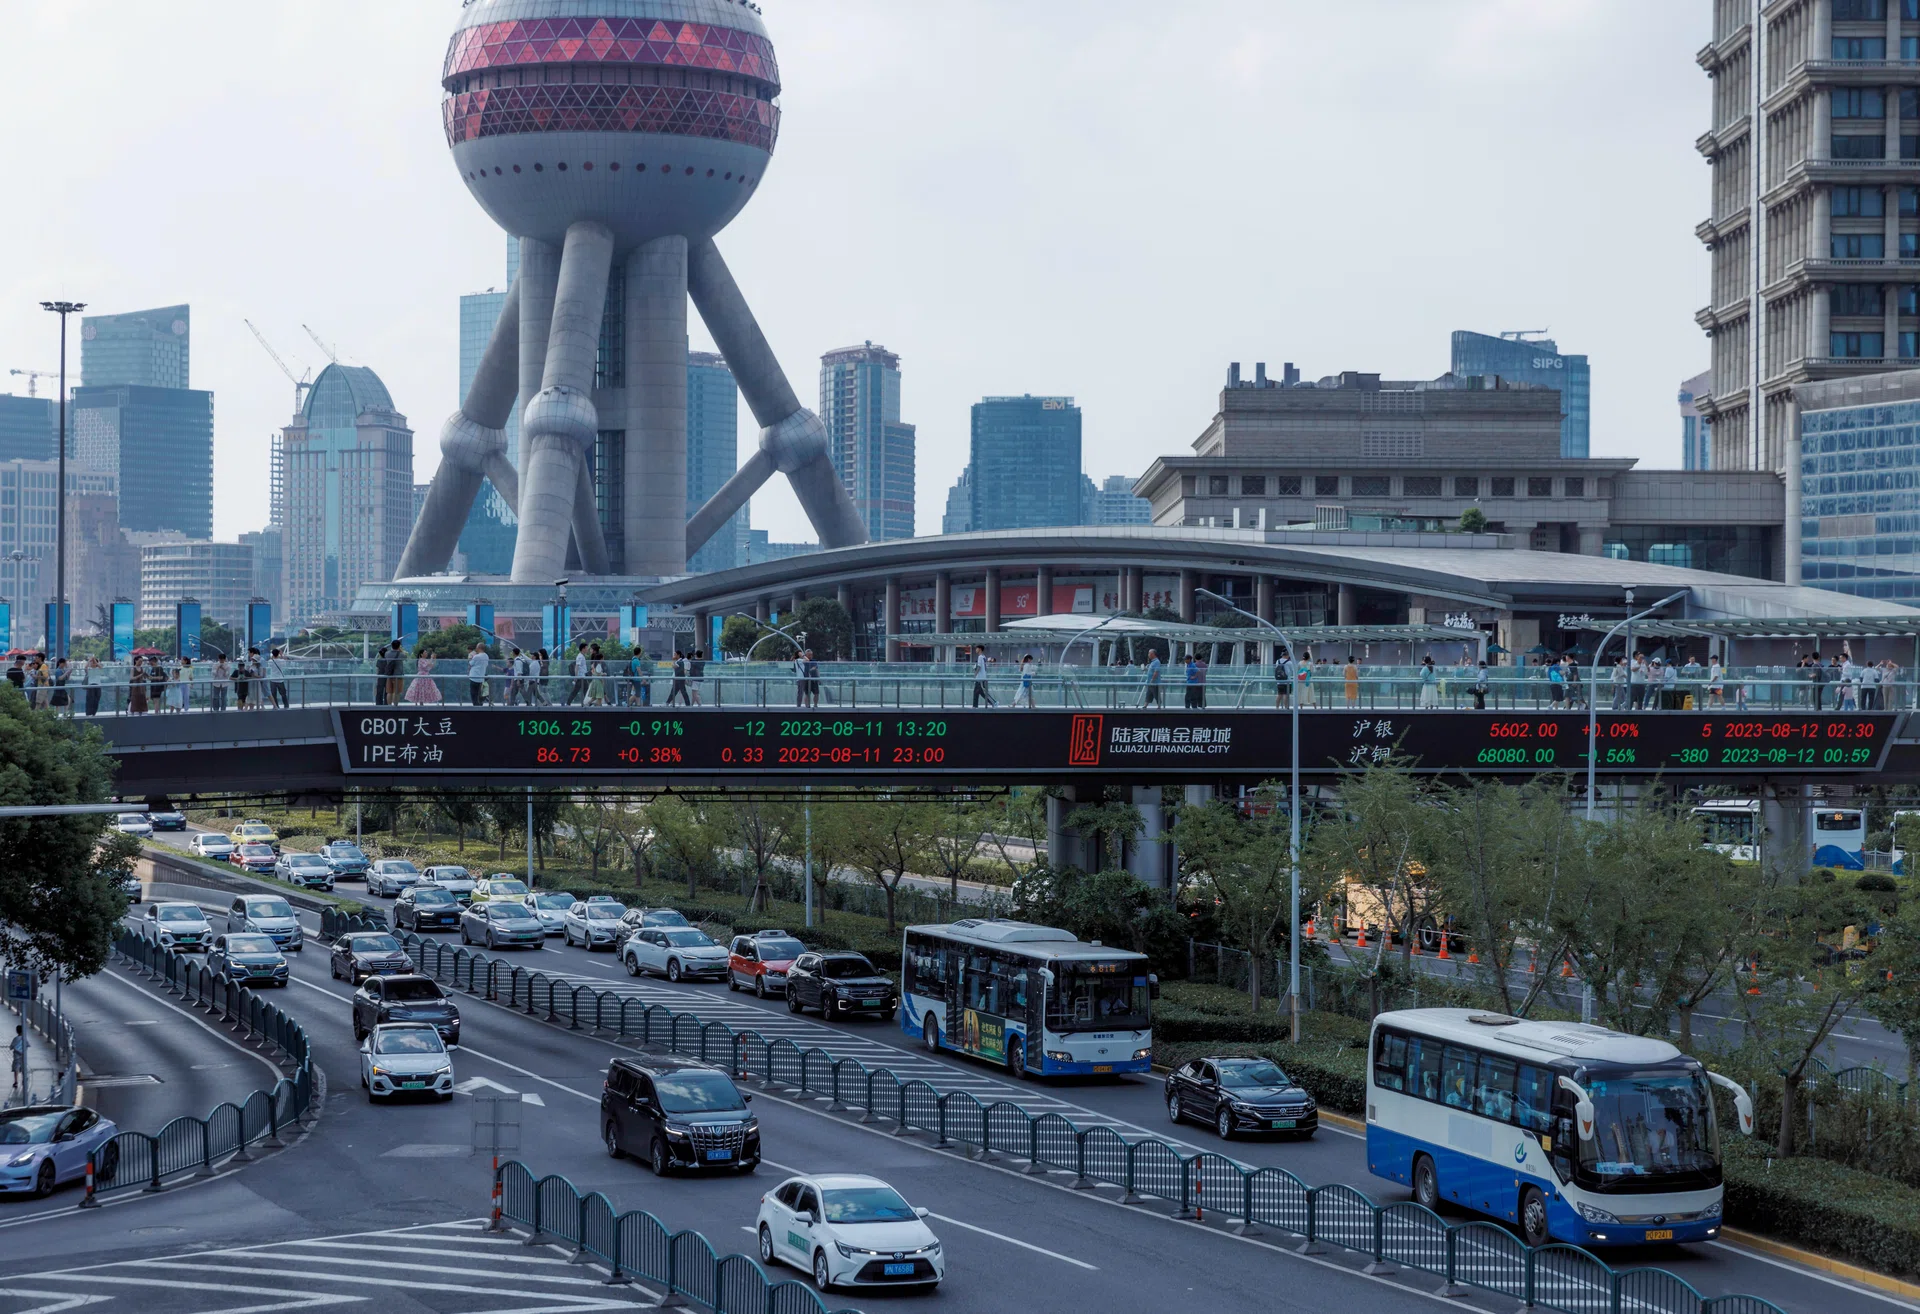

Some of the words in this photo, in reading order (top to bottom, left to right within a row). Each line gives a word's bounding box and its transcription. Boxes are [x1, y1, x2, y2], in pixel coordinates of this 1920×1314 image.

[1532, 358, 1563, 369] SIPG
[360, 717, 457, 736] CBOT大豆
[518, 720, 592, 736] 1306.25
[619, 720, 683, 736] -0.91%
[734, 721, 765, 736] -12
[780, 721, 883, 736] 2023-08-11
[896, 721, 947, 736] 13:20
[1353, 719, 1394, 738] 沪银
[1489, 723, 1559, 738] 5602.00
[1701, 723, 1712, 738] 5
[1725, 723, 1819, 738] 2023-08-12
[1827, 723, 1875, 738] 02:30
[1111, 727, 1231, 743] 陆家嘴金融城
[363, 744, 444, 764] IPE布油
[537, 747, 591, 763] 86.73
[618, 747, 682, 763] +0.38%
[721, 747, 764, 763] 0.33
[778, 747, 881, 763] 2023-08-11
[893, 747, 945, 763] 23:00
[1110, 745, 1154, 753] LUJIAZUI
[1155, 745, 1206, 753] FINANCIAL
[1207, 745, 1231, 753] CITY
[1477, 748, 1555, 763] 68080.00
[1671, 748, 1709, 763] -380
[1721, 748, 1816, 763] 2023-08-12
[1823, 748, 1871, 763] 00:59
[1834, 813, 1843, 821] 85
